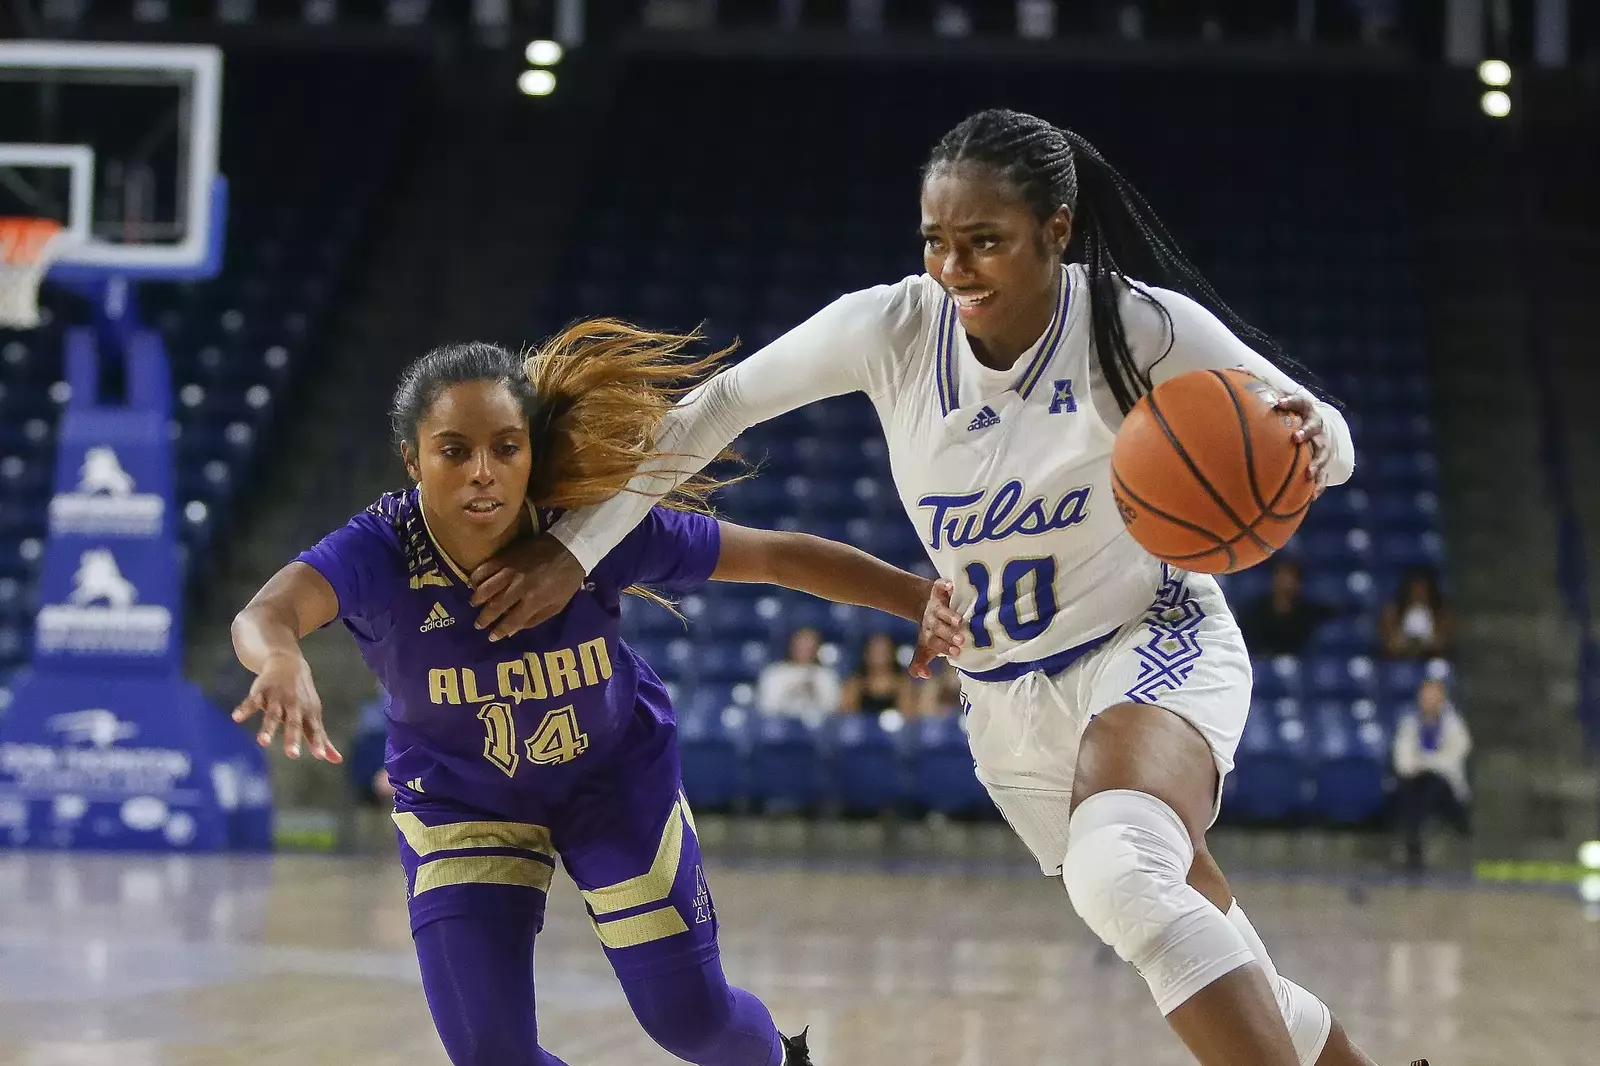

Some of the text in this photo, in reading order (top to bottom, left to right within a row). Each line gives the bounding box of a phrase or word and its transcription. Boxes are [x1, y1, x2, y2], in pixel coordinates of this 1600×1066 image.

[967, 416, 1001, 432] adidas
[918, 477, 1094, 551] Tulsa
[419, 616, 456, 633] adidas
[964, 554, 1060, 649] 10
[428, 636, 613, 705] ALCORN
[476, 702, 589, 778] 14
